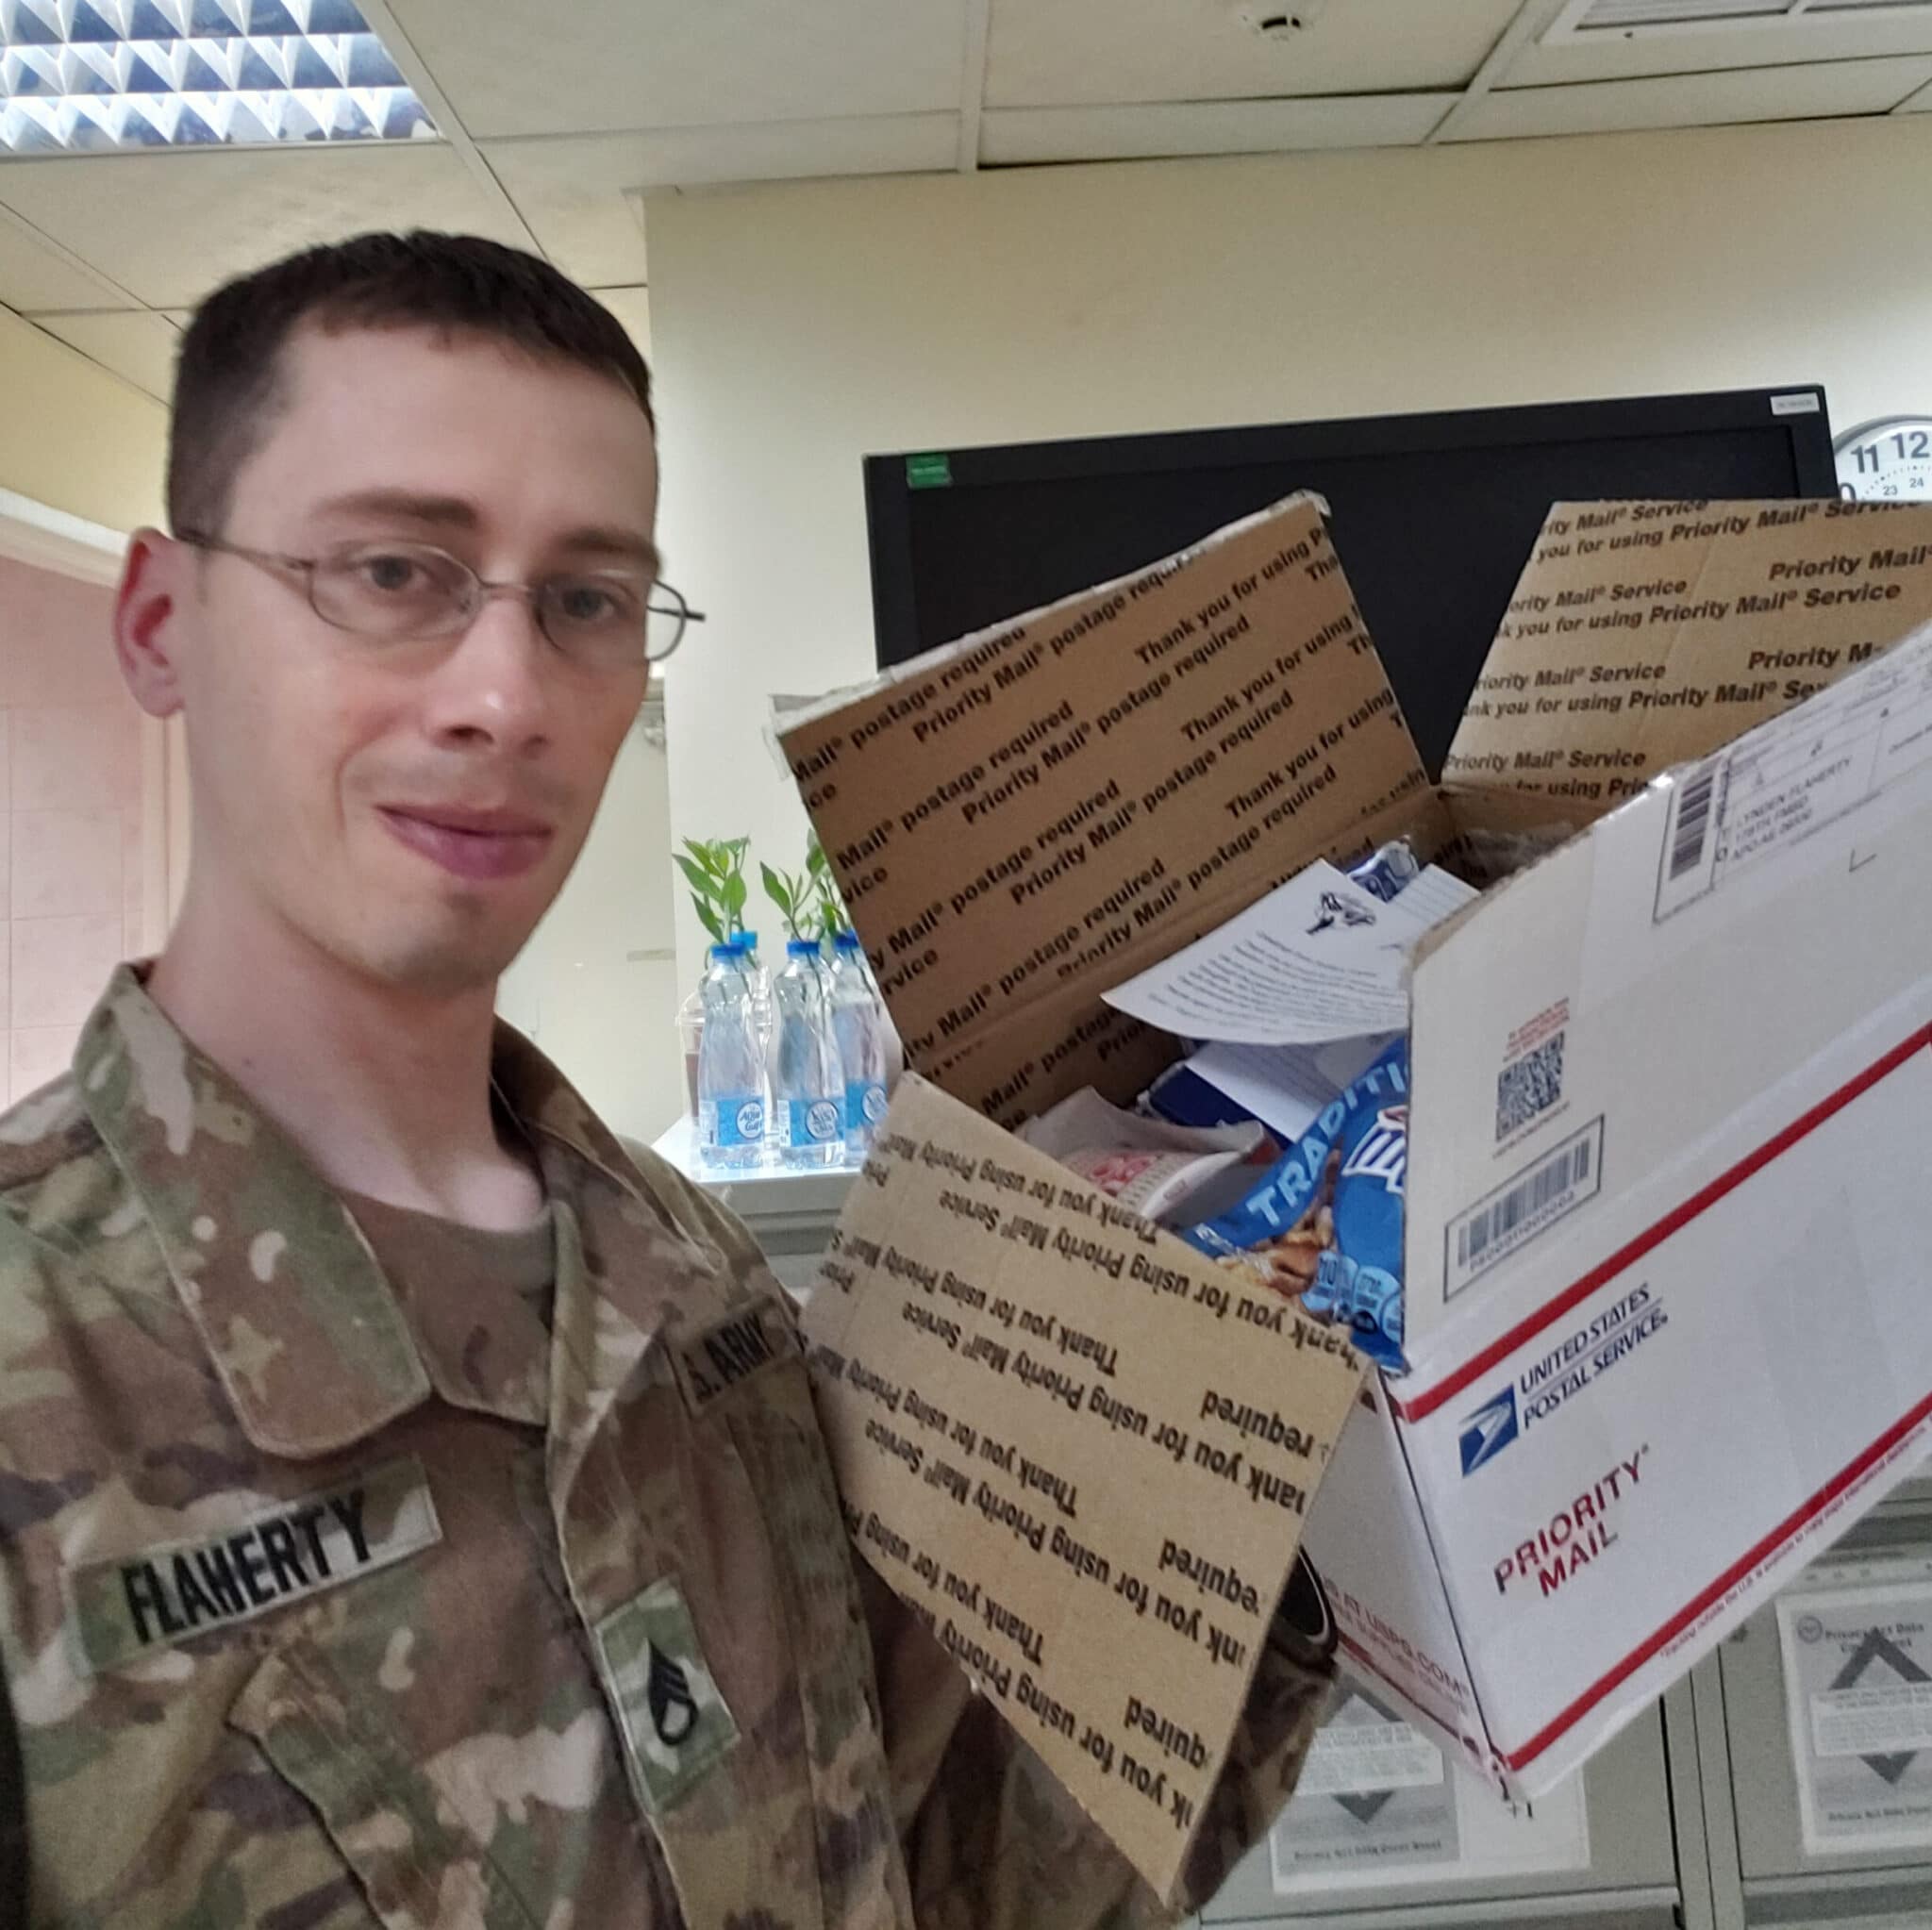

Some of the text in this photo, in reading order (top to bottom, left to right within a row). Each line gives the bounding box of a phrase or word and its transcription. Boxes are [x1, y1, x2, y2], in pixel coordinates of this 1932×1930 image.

[1850, 444, 1879, 474] 11
[1890, 430, 1930, 459] 12
[1537, 543, 1570, 563] you
[1576, 538, 1604, 555] for
[1609, 528, 1664, 551] using
[1670, 515, 1750, 542] Priority
[1609, 578, 1688, 602] Service
[1769, 554, 1861, 581] Priority
[1134, 541, 1310, 666] Thank you for using
[1516, 618, 1551, 639] you
[1557, 615, 1583, 634] for
[1589, 607, 1643, 631] using
[1649, 600, 1729, 624] Priority
[1804, 581, 1901, 608] Service
[912, 682, 992, 743] Priority
[1049, 596, 1127, 657] postage
[1181, 694, 1241, 743] Thank
[1241, 666, 1274, 704] you
[1274, 647, 1303, 678] for
[1305, 614, 1354, 657] using
[1590, 662, 1667, 683] Service
[1747, 642, 1840, 672] Priority
[849, 683, 939, 751] postage
[960, 764, 1040, 825] Priority
[1096, 672, 1171, 735] postage
[1174, 613, 1251, 679] required
[1494, 700, 1529, 720] you
[1536, 694, 1562, 713] for
[1568, 690, 1622, 713] using
[1628, 683, 1709, 709] Priority
[899, 764, 986, 833] postage
[988, 700, 1074, 770] required
[1225, 771, 1285, 821] Thank
[1284, 743, 1319, 781] you
[1319, 723, 1347, 751] for
[1348, 686, 1394, 730] using
[1569, 750, 1646, 770] Service
[1009, 843, 1087, 907] Priority
[1141, 749, 1217, 815] postage
[1219, 688, 1294, 755] required
[1548, 778, 1601, 799] using
[950, 844, 1033, 915] postage
[1035, 778, 1122, 851] required
[1187, 826, 1260, 890] postage
[1262, 763, 1339, 830] required
[998, 923, 1081, 996] postage
[1083, 857, 1166, 930] required
[921, 1140, 977, 1183] Priority
[1245, 1061, 1408, 1227] TRADITI
[980, 1156, 1025, 1193] using
[1028, 1178, 1056, 1208] for
[940, 1189, 1001, 1232] Service
[1058, 1190, 1097, 1217] you
[882, 1245, 940, 1295] Priority
[1052, 1226, 1125, 1280] Priority
[1129, 1252, 1190, 1298] using
[941, 1270, 987, 1310] using
[990, 1297, 1016, 1329] for
[1193, 1282, 1230, 1320] for
[1235, 1296, 1287, 1335] you
[902, 1301, 962, 1351] Service
[1019, 1309, 1057, 1341] you
[1058, 1324, 1118, 1377] Thank
[1290, 1321, 1359, 1372] hank
[1520, 1281, 1651, 1395] UNITED STATES
[846, 1357, 903, 1414] Priority
[1011, 1350, 1085, 1413] Priority
[1522, 1366, 1592, 1430] POSTAL
[903, 1389, 949, 1431] using
[1088, 1385, 1150, 1436] using
[1200, 1389, 1315, 1459] required
[865, 1418, 924, 1475] Service
[950, 1420, 977, 1456] for
[979, 1435, 1017, 1474] you
[1151, 1422, 1190, 1463] for
[1194, 1439, 1244, 1484] you
[1018, 1456, 1078, 1519] Thank
[864, 1510, 910, 1565] using
[973, 1479, 1047, 1555] Priority
[120, 1488, 372, 1646] FLAHERTY
[911, 1551, 941, 1591] for
[1049, 1524, 1111, 1579] using
[1537, 1520, 1620, 1599] MAIL
[943, 1570, 982, 1612] you
[1113, 1571, 1150, 1617] for
[983, 1596, 1044, 1668] Thank
[1154, 1591, 1204, 1643] you
[941, 1618, 1169, 1807] you for using Priority
